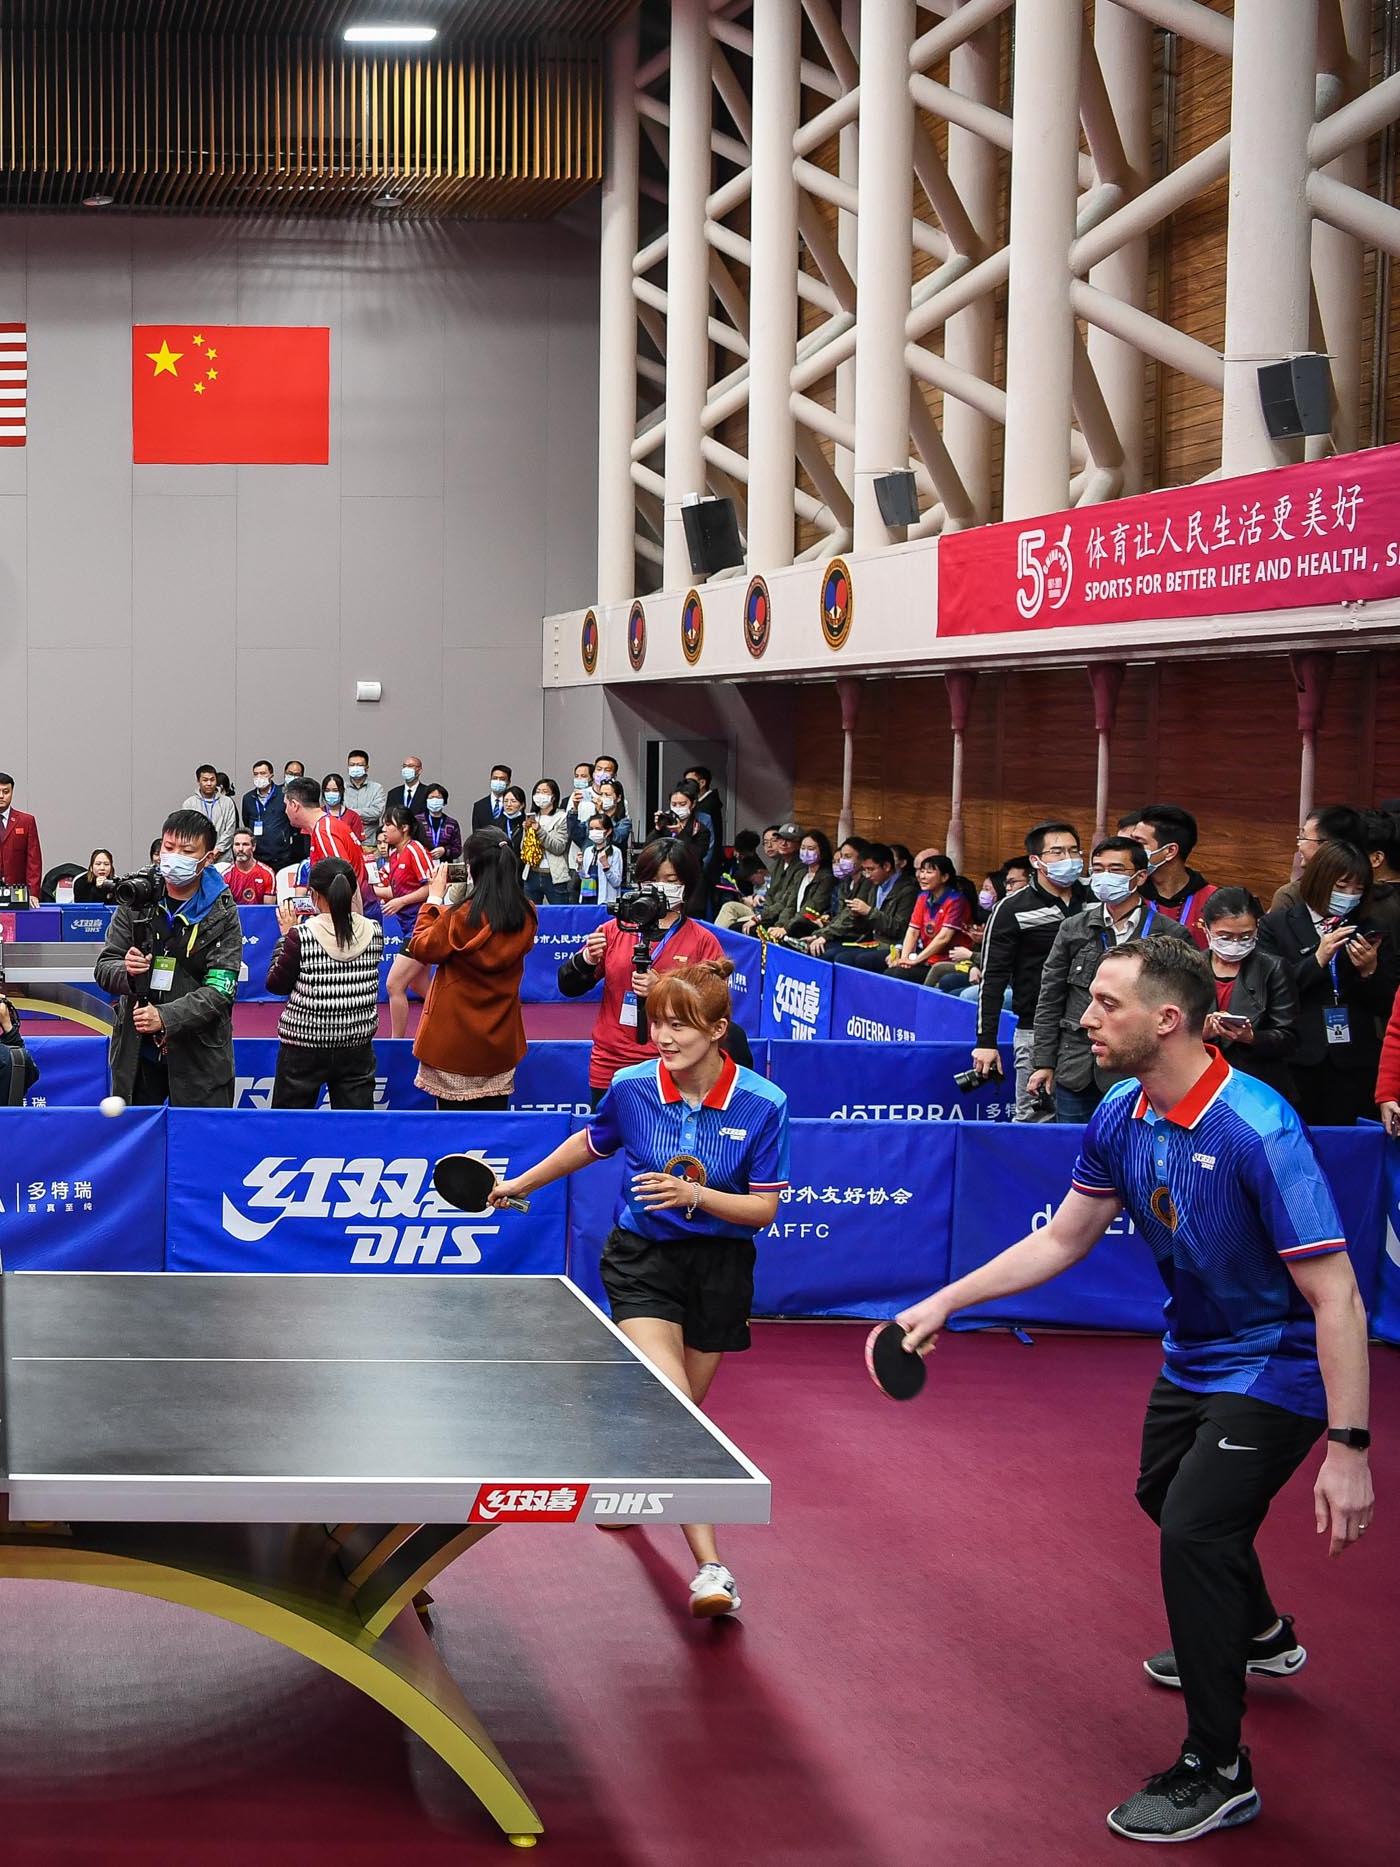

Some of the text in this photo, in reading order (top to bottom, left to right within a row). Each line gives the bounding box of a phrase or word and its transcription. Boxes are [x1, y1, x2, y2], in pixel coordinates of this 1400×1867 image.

[1086, 484, 1364, 569] 体育让人民生活更美好
[1085, 577, 1133, 602] SPORTS
[1136, 574, 1163, 596] FOR
[1166, 566, 1217, 593] BETTER
[1221, 561, 1251, 587] LIFE
[1255, 557, 1292, 583] AND
[1386, 542, 1400, 567] S
[773, 974, 821, 1025] 红双喜
[27, 1181, 92, 1200] 多特瑞
[27, 1202, 93, 1213] 至真至纯
[344, 1225, 500, 1265] DHS
[479, 1487, 578, 1519] 红双喜
[591, 1492, 674, 1514] DHS
